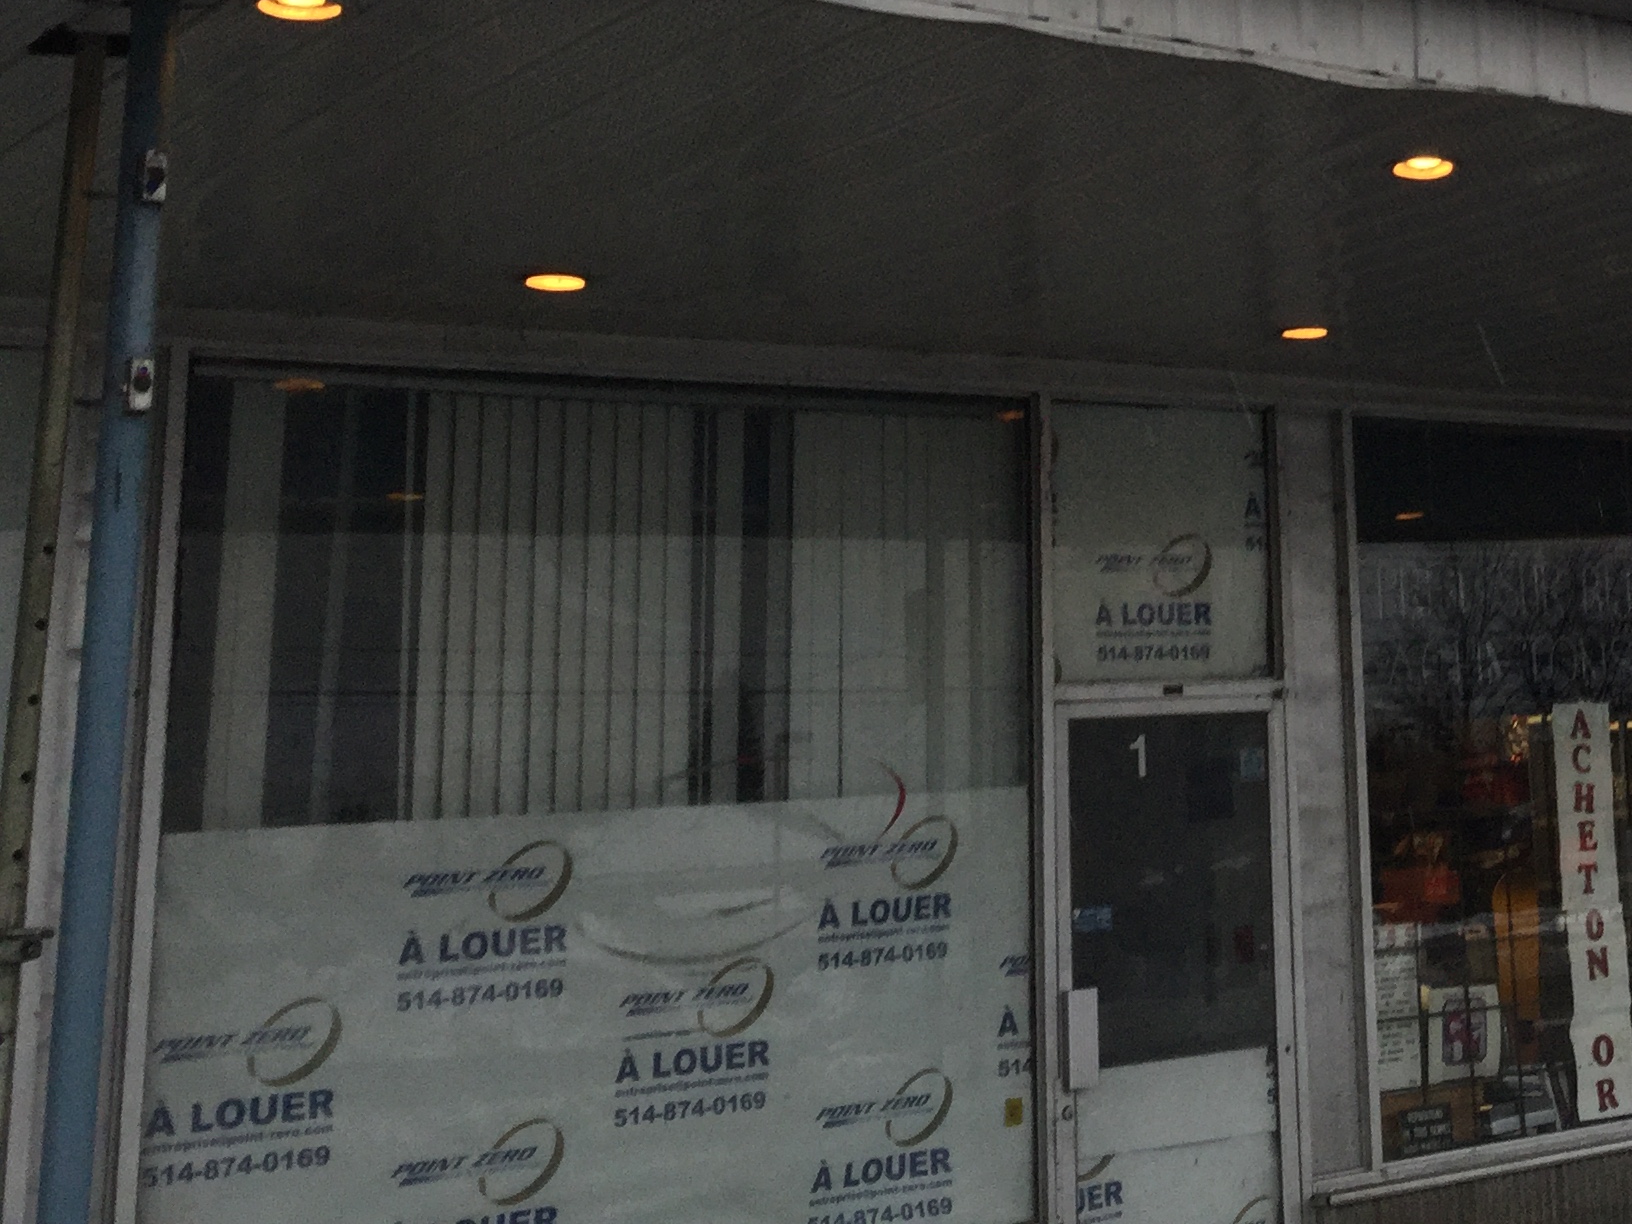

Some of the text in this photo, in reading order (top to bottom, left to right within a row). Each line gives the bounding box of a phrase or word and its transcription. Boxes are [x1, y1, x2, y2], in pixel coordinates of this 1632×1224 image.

[1121, 601, 1212, 626] LOUER
[1129, 734, 1147, 777] 1
[852, 891, 951, 927] LOUER
[439, 924, 567, 963] LOUER
[818, 941, 948, 971] 514-874-0169
[397, 977, 564, 1012] 514-874-0169
[653, 1039, 770, 1078] LOUER
[1591, 1033, 1620, 1112] OR
[191, 1088, 334, 1133] LOUER
[614, 1090, 766, 1127] 514-874-0169
[143, 1145, 331, 1188] 514-874-0169
[844, 1147, 952, 1189] LOUER
